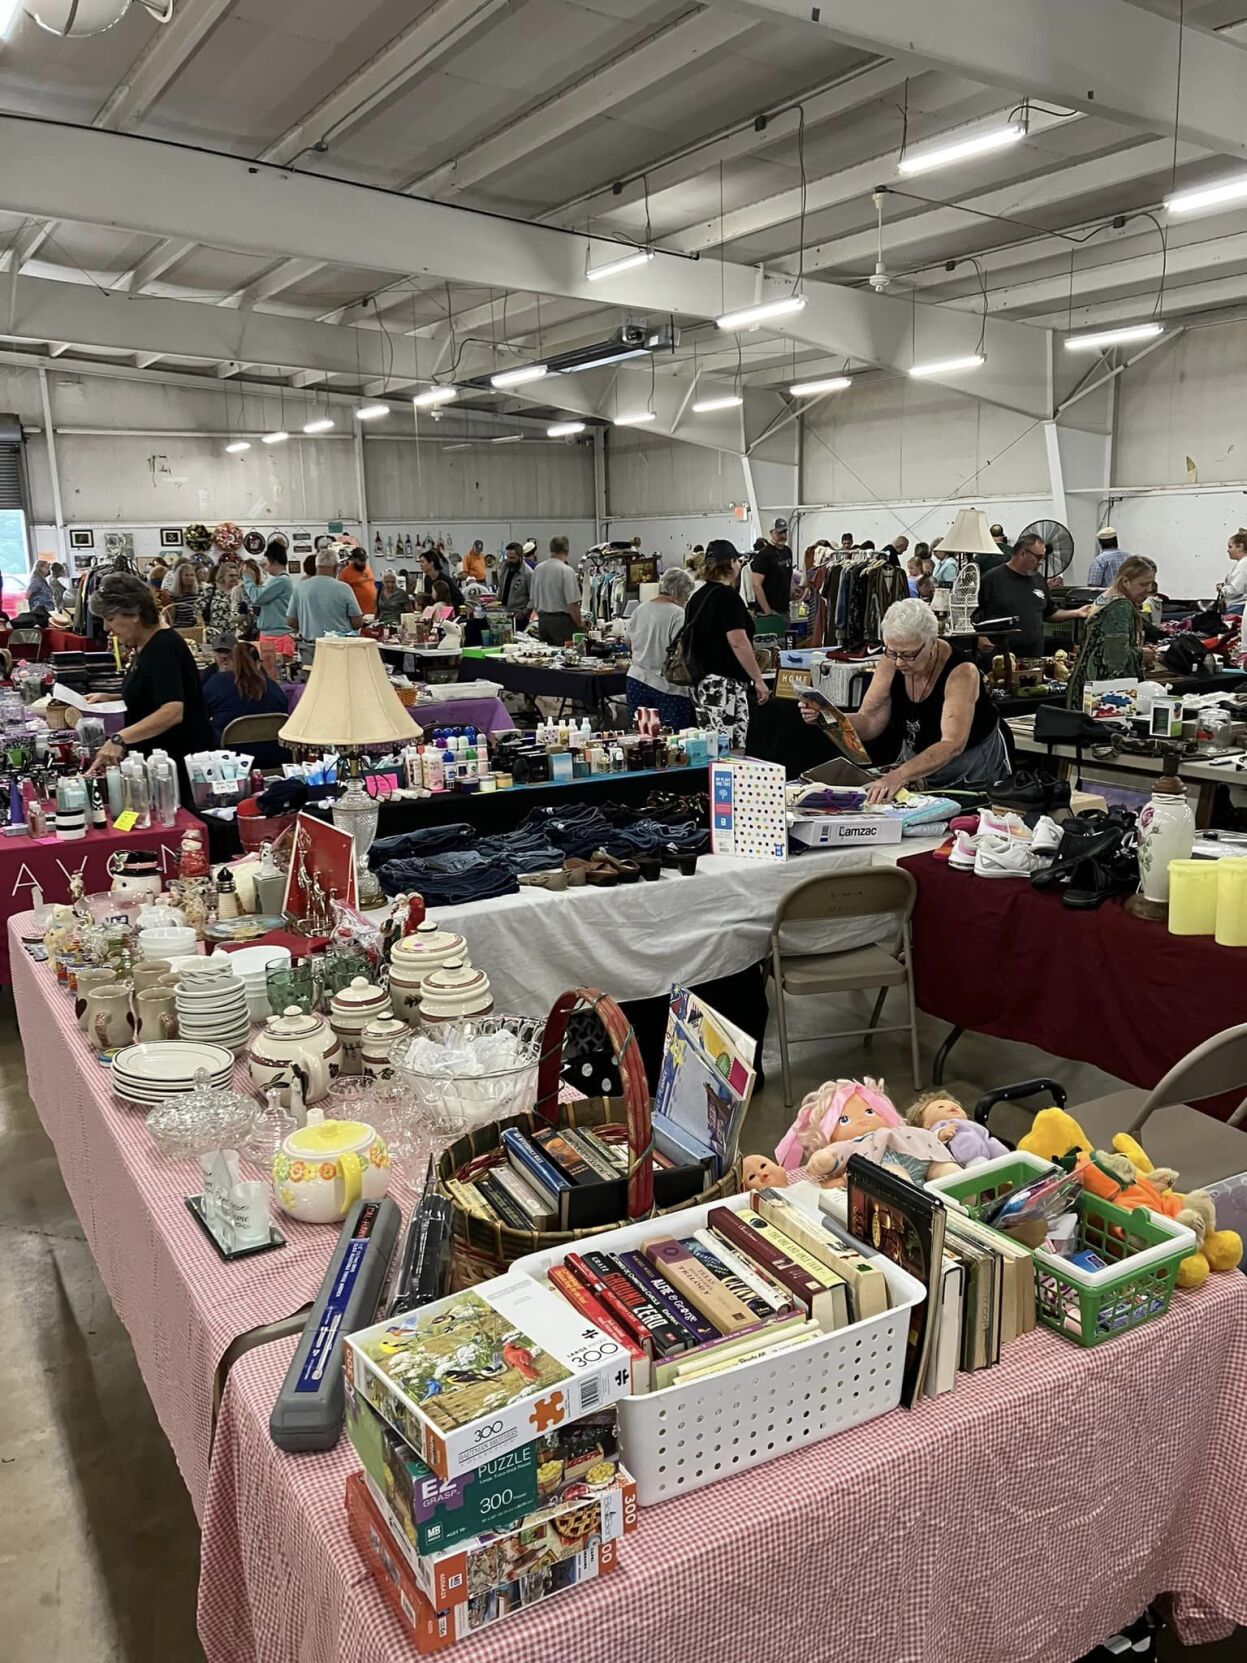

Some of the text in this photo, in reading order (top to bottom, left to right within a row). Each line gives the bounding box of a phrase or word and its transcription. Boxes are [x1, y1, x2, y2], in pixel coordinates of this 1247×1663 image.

[782, 674, 808, 684] HOME
[591, 1256, 610, 1272] GRATZ
[679, 1266, 710, 1295] TRILOGY
[603, 1272, 668, 1329] GROUND ZERO
[651, 1279, 674, 1295] ALFIE
[674, 1300, 697, 1322] George
[567, 1347, 587, 1358] LARGE
[572, 1343, 618, 1367] 300
[475, 1421, 503, 1443] 300
[478, 1447, 531, 1479] PUZZLE
[423, 1489, 458, 1508] GRASP
[480, 1488, 513, 1514] 300
[625, 1494, 636, 1524] 300
[427, 1525, 441, 1538] MB
[602, 1543, 612, 1564] 00
